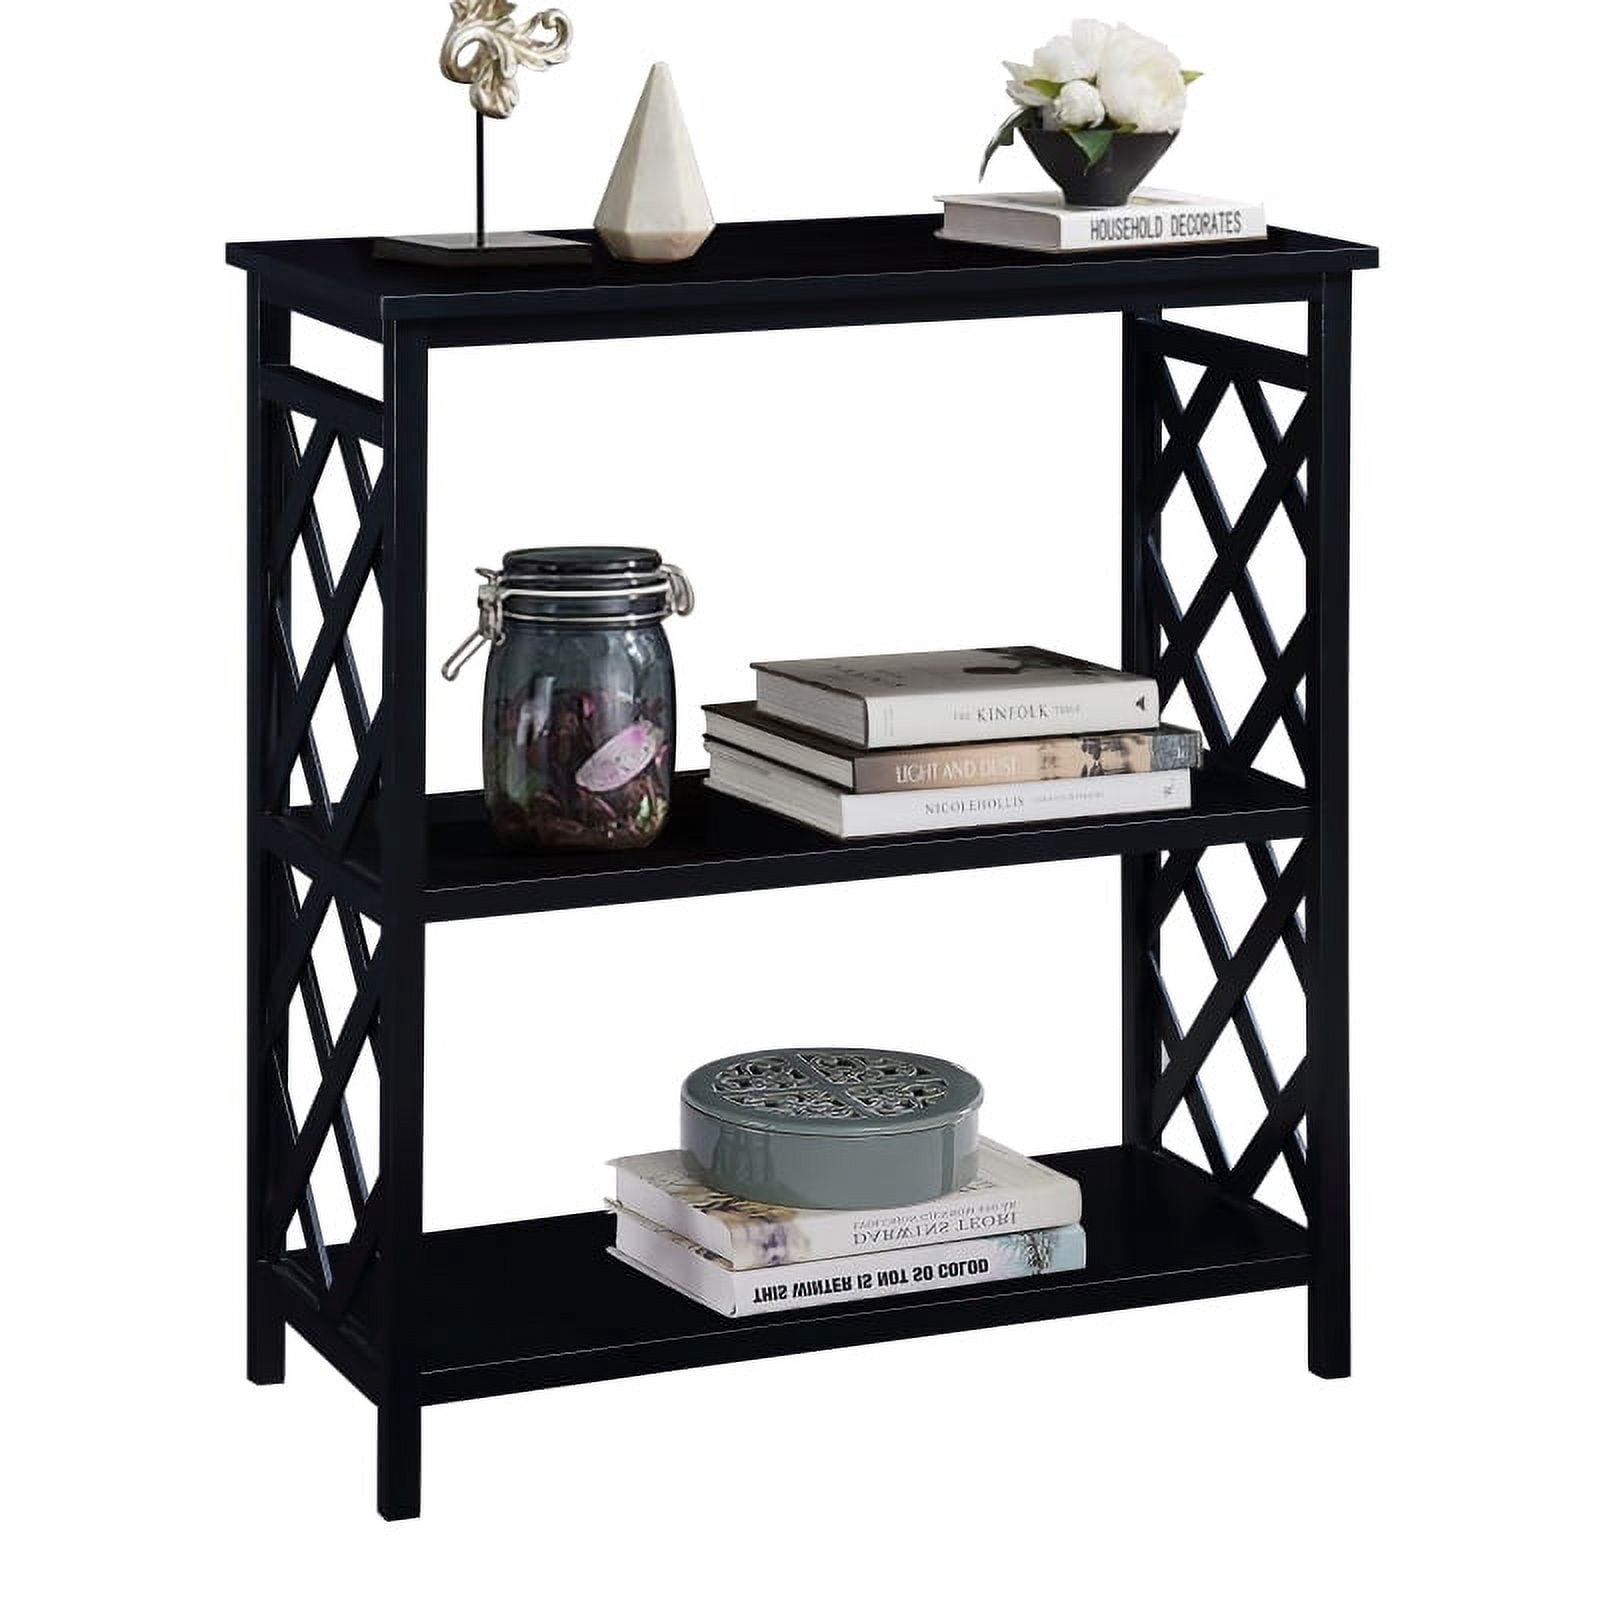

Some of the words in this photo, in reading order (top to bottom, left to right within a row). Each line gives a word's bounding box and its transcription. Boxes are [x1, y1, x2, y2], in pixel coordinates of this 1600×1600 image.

[1090, 214, 1163, 241] HOUSEHOLD
[1170, 210, 1242, 237] DECORATES
[977, 703, 1049, 722] KINFOLK
[942, 760, 977, 782] AND
